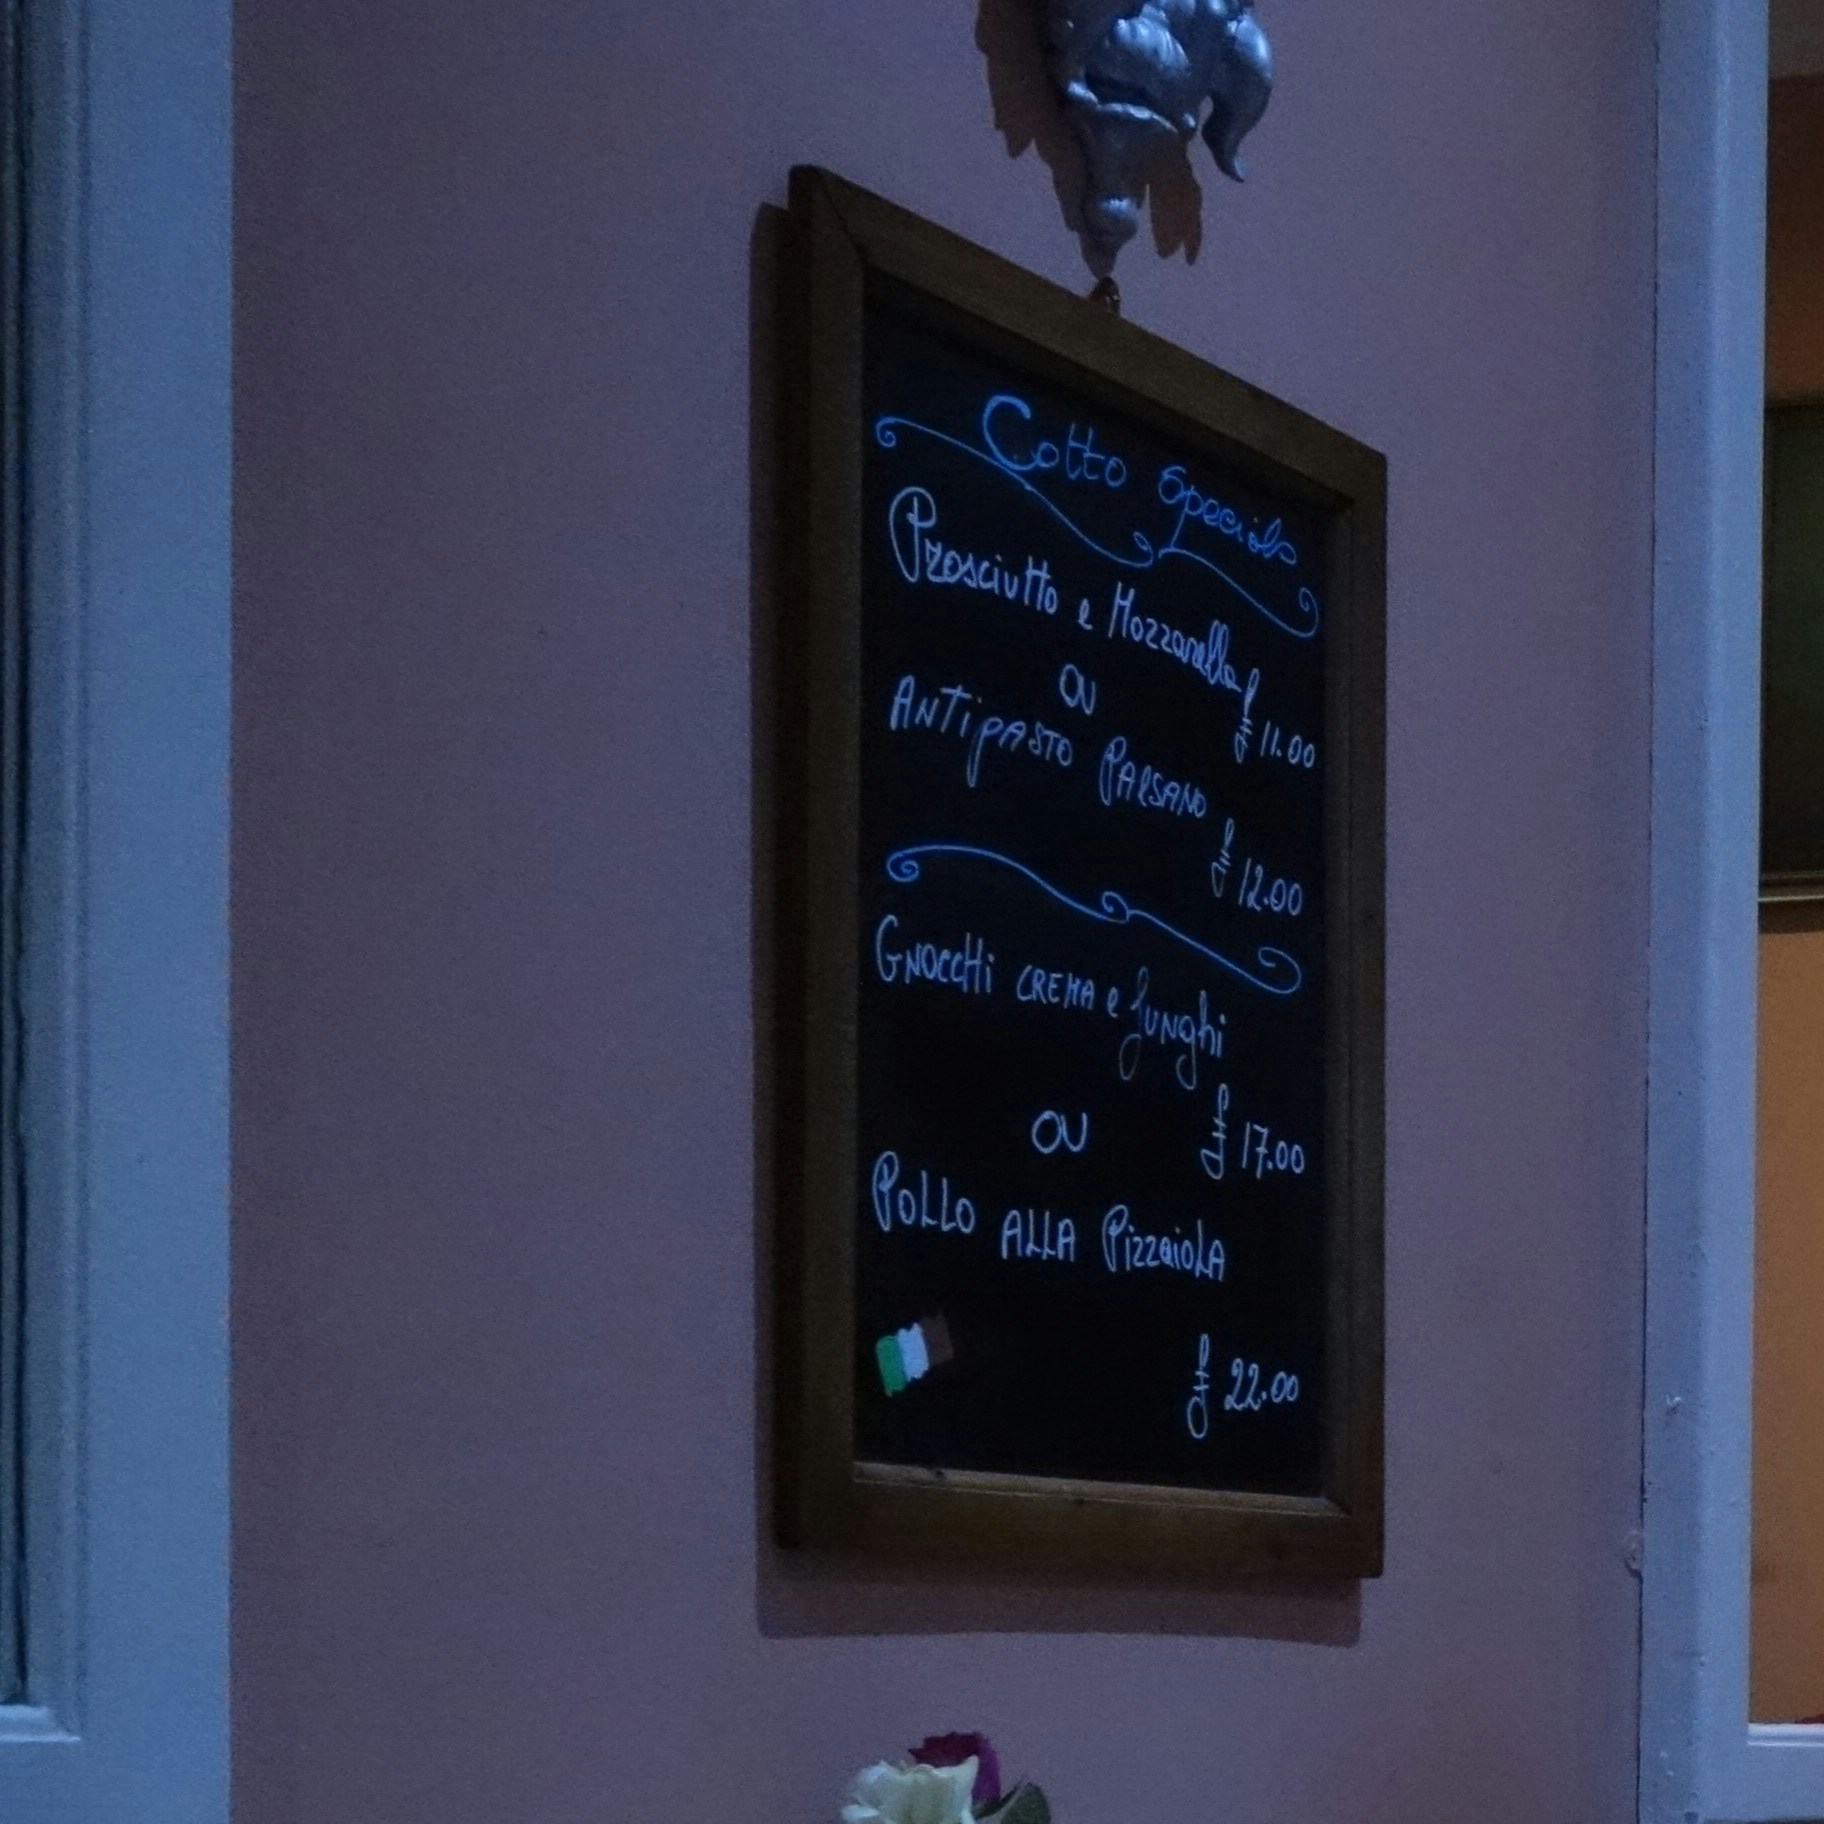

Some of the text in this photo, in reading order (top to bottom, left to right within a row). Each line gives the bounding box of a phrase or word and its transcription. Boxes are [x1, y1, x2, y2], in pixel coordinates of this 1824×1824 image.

[982, 395, 1298, 566] Cotto Specials
[888, 485, 1059, 616] Prosciutto
[1078, 598, 1095, 632] e
[1016, 964, 1097, 1012] CREMA
[1106, 985, 1120, 1020] e
[1000, 1208, 1077, 1264] ALLA
